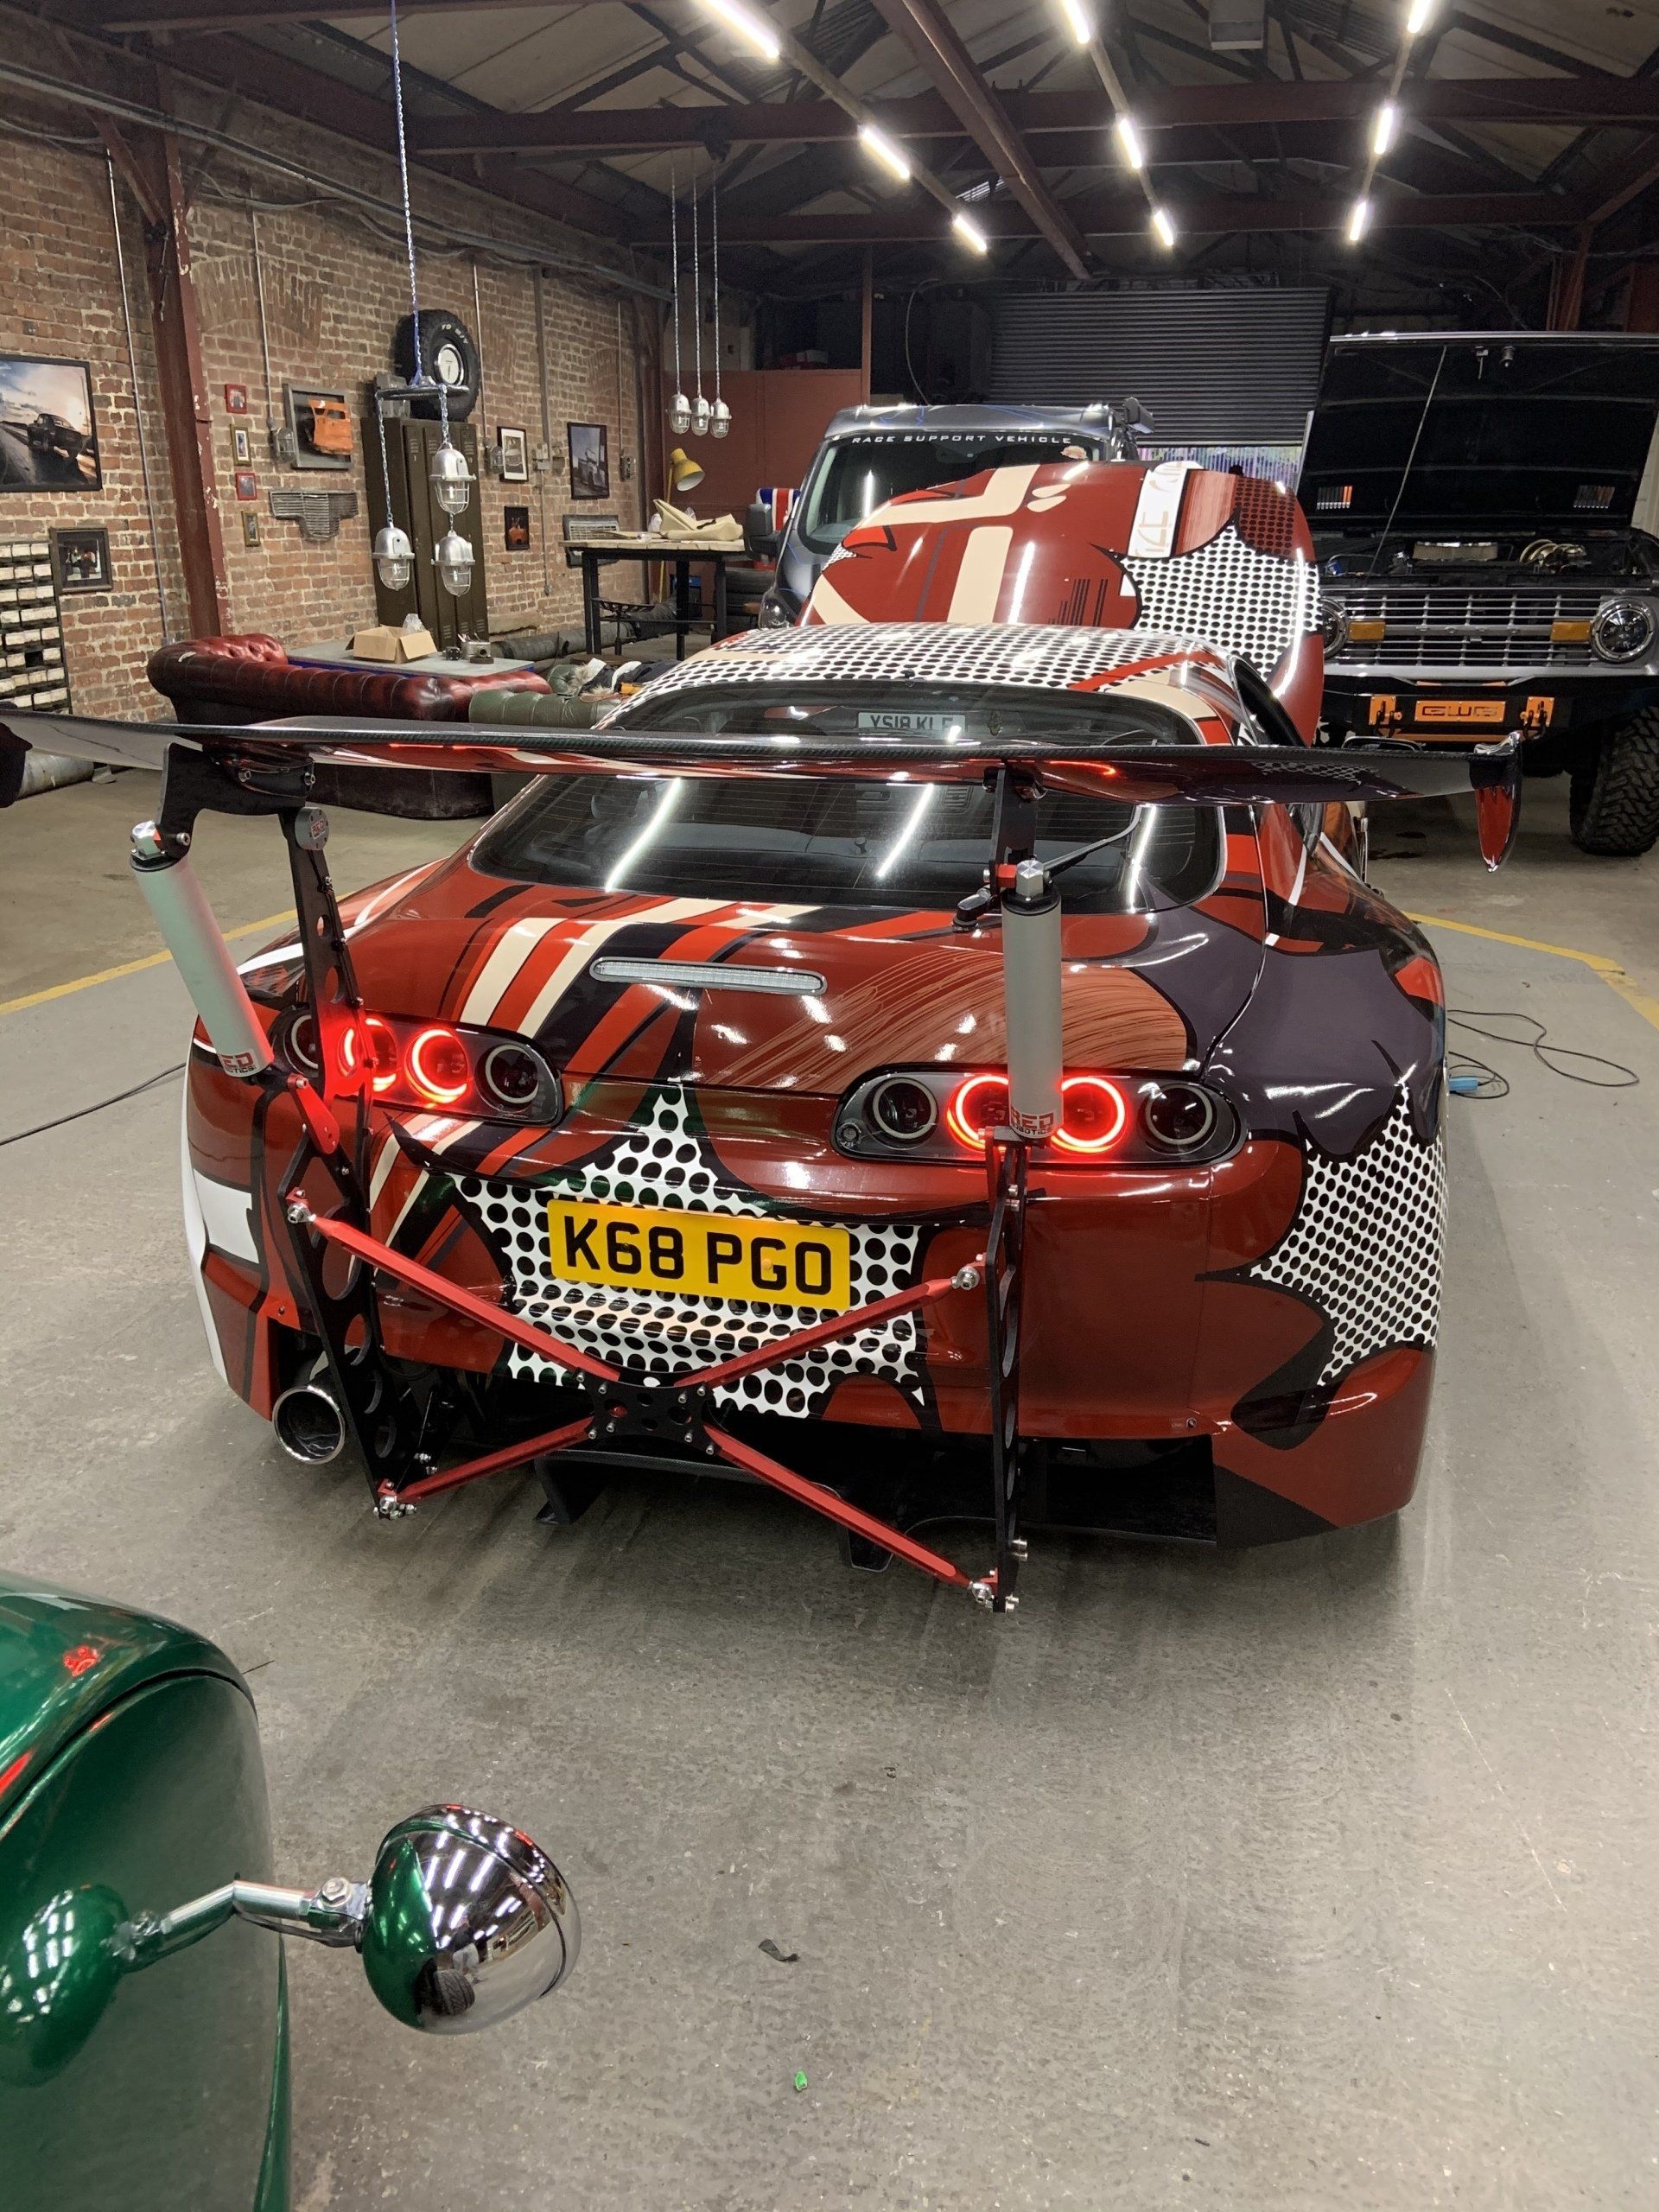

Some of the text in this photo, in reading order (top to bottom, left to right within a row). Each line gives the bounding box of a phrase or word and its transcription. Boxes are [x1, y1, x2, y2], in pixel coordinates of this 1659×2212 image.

[995, 435, 1071, 444] VEHICLE
[220, 1052, 254, 1068] ED
[1011, 1106, 1054, 1129] RED
[563, 1215, 832, 1296] K68 PGO
